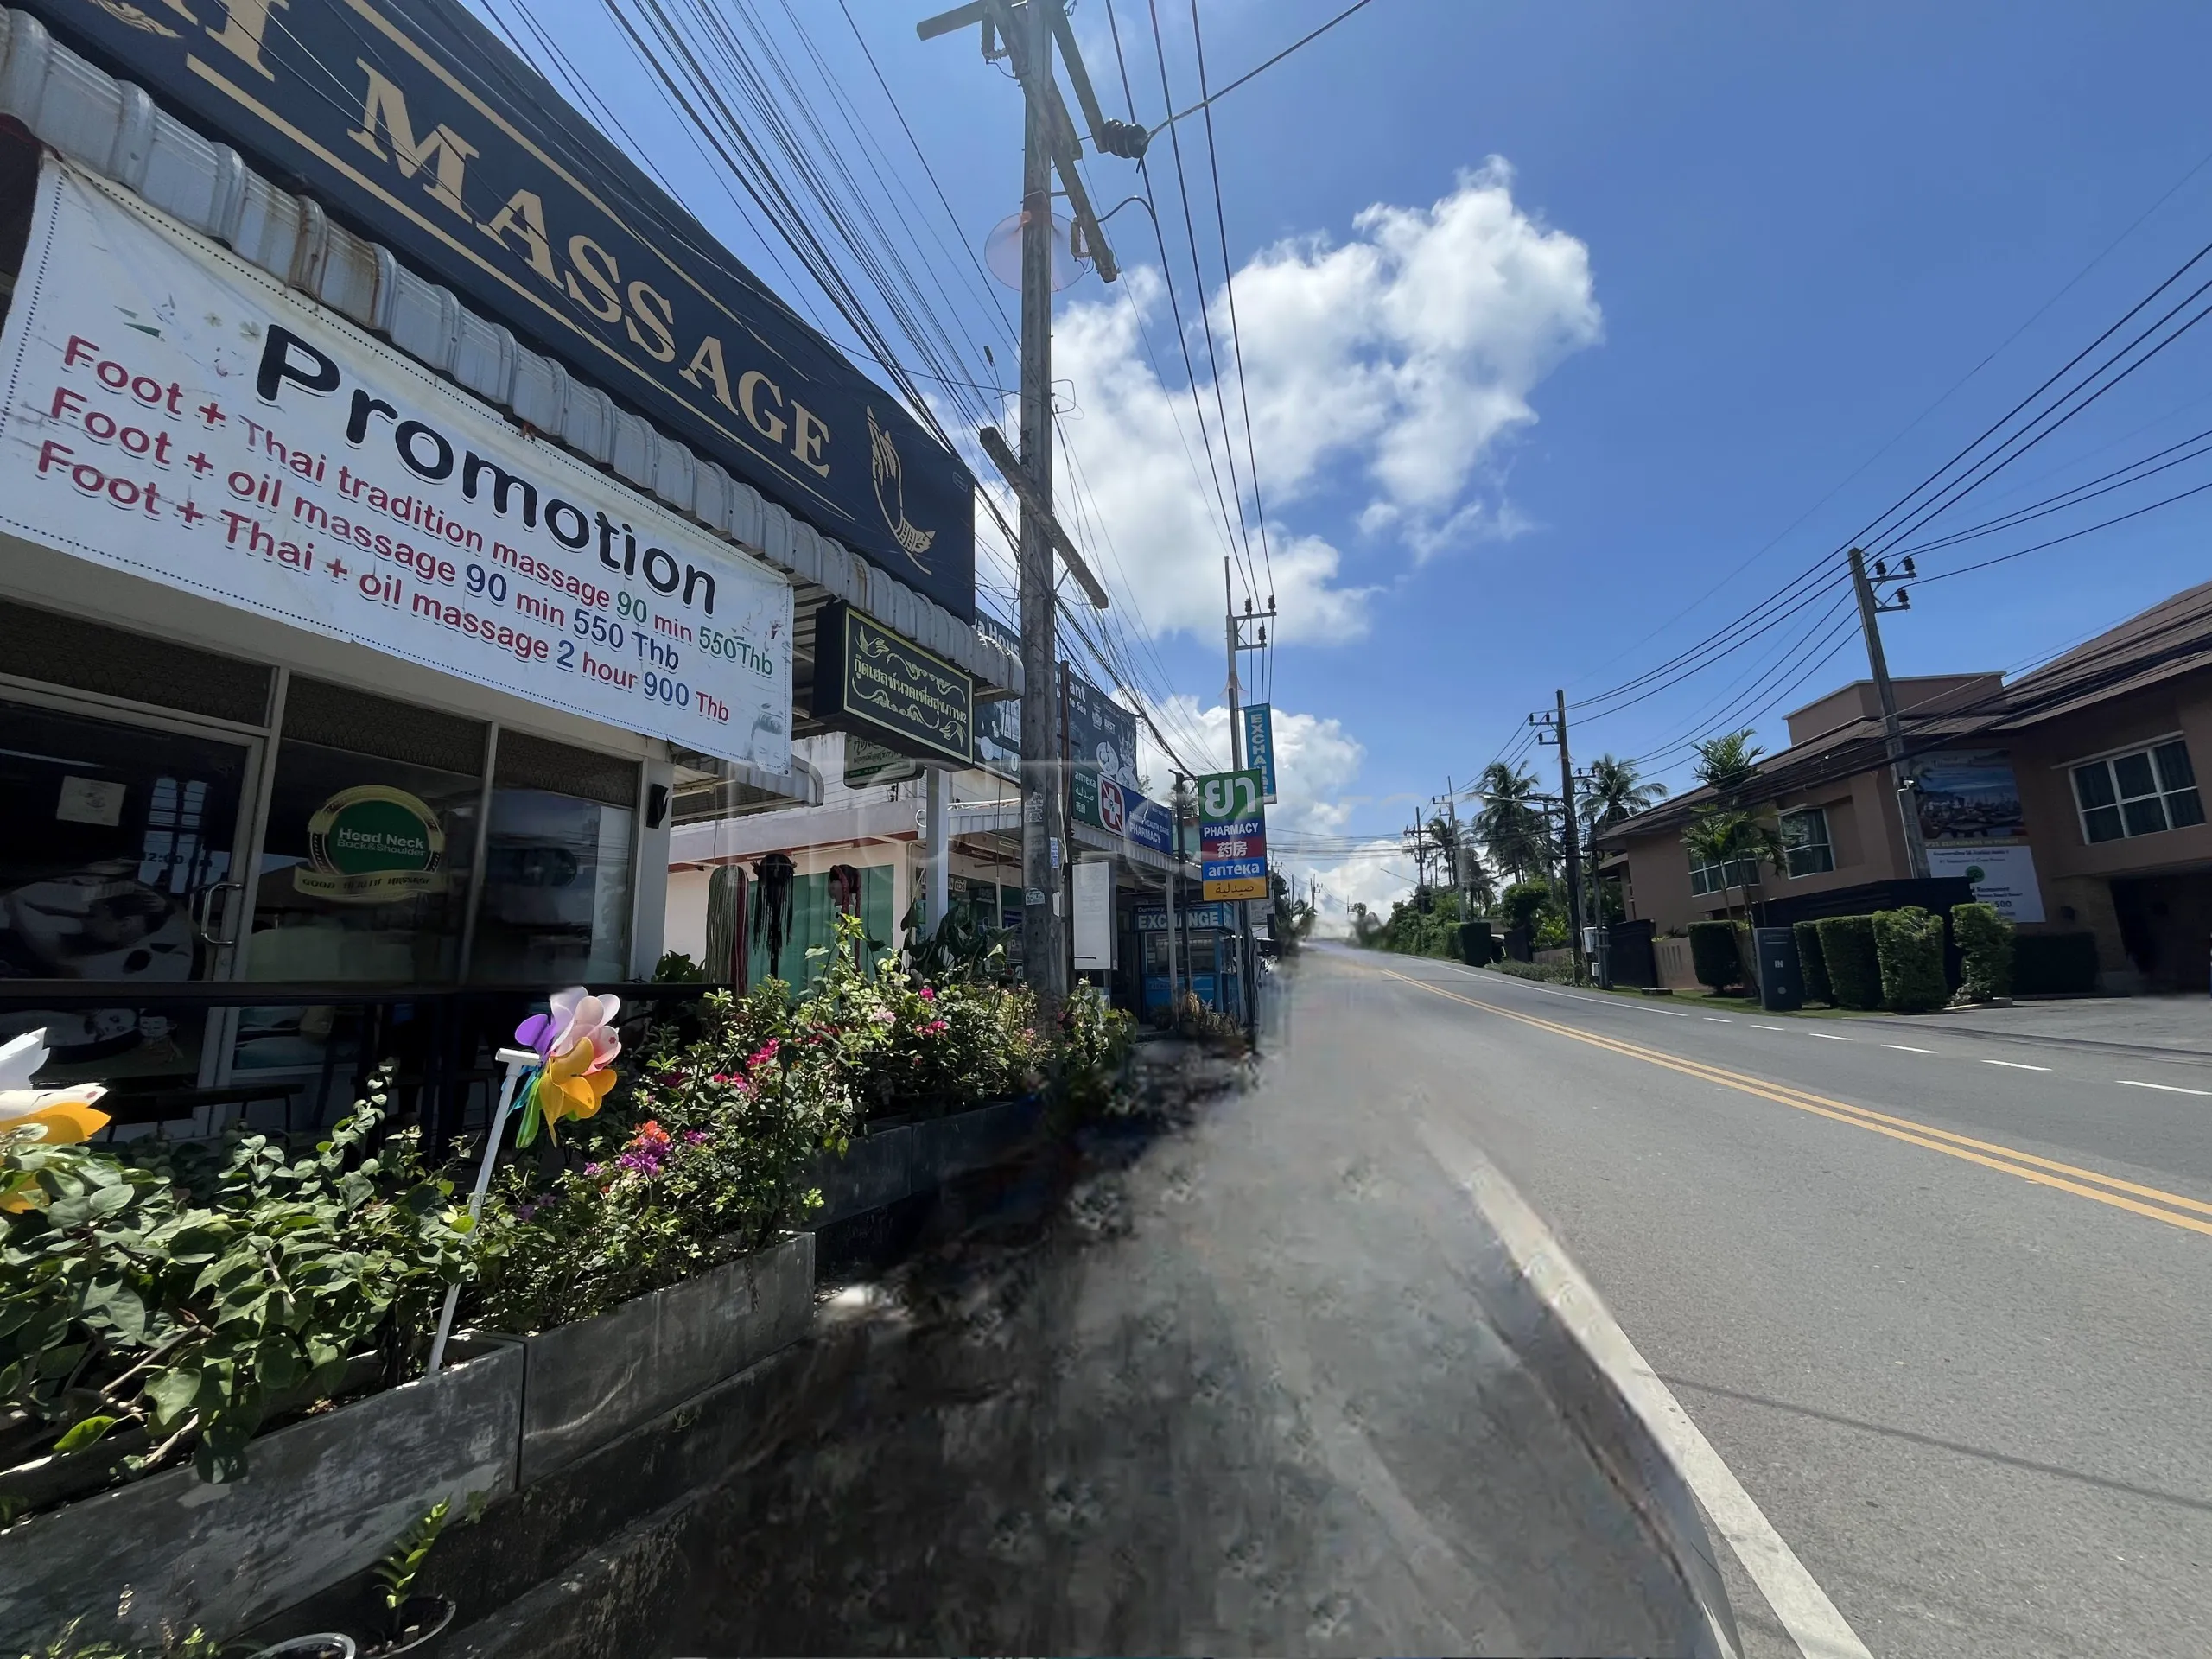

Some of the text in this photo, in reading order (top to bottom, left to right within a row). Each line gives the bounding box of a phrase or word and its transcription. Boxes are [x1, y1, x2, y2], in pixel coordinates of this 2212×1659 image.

[347, 57, 831, 478] MASSAGE
[257, 324, 716, 615] Promotion
[64, 335, 183, 415] Foot
[198, 402, 226, 424] +
[239, 414, 326, 481] Thai
[339, 466, 483, 551] tradition
[493, 540, 610, 607] massage
[616, 591, 647, 623] 90
[654, 614, 692, 642] min
[51, 387, 679, 671] Foot + oil massage 90 min 550 Thb
[38, 440, 729, 722] Foot + Thai + oil massage 2 hour 900 Thb
[988, 623, 1020, 657] Hous
[1205, 777, 1256, 817] ยา
[339, 827, 424, 849] Head Neck
[1129, 822, 1161, 843] PHARMACY
[1204, 823, 1259, 837] PHARMACY
[1217, 841, 1248, 858] 药房
[1208, 862, 1260, 877] аптека
[302, 879, 335, 889] GOOD
[1215, 882, 1254, 897] صيدلية
